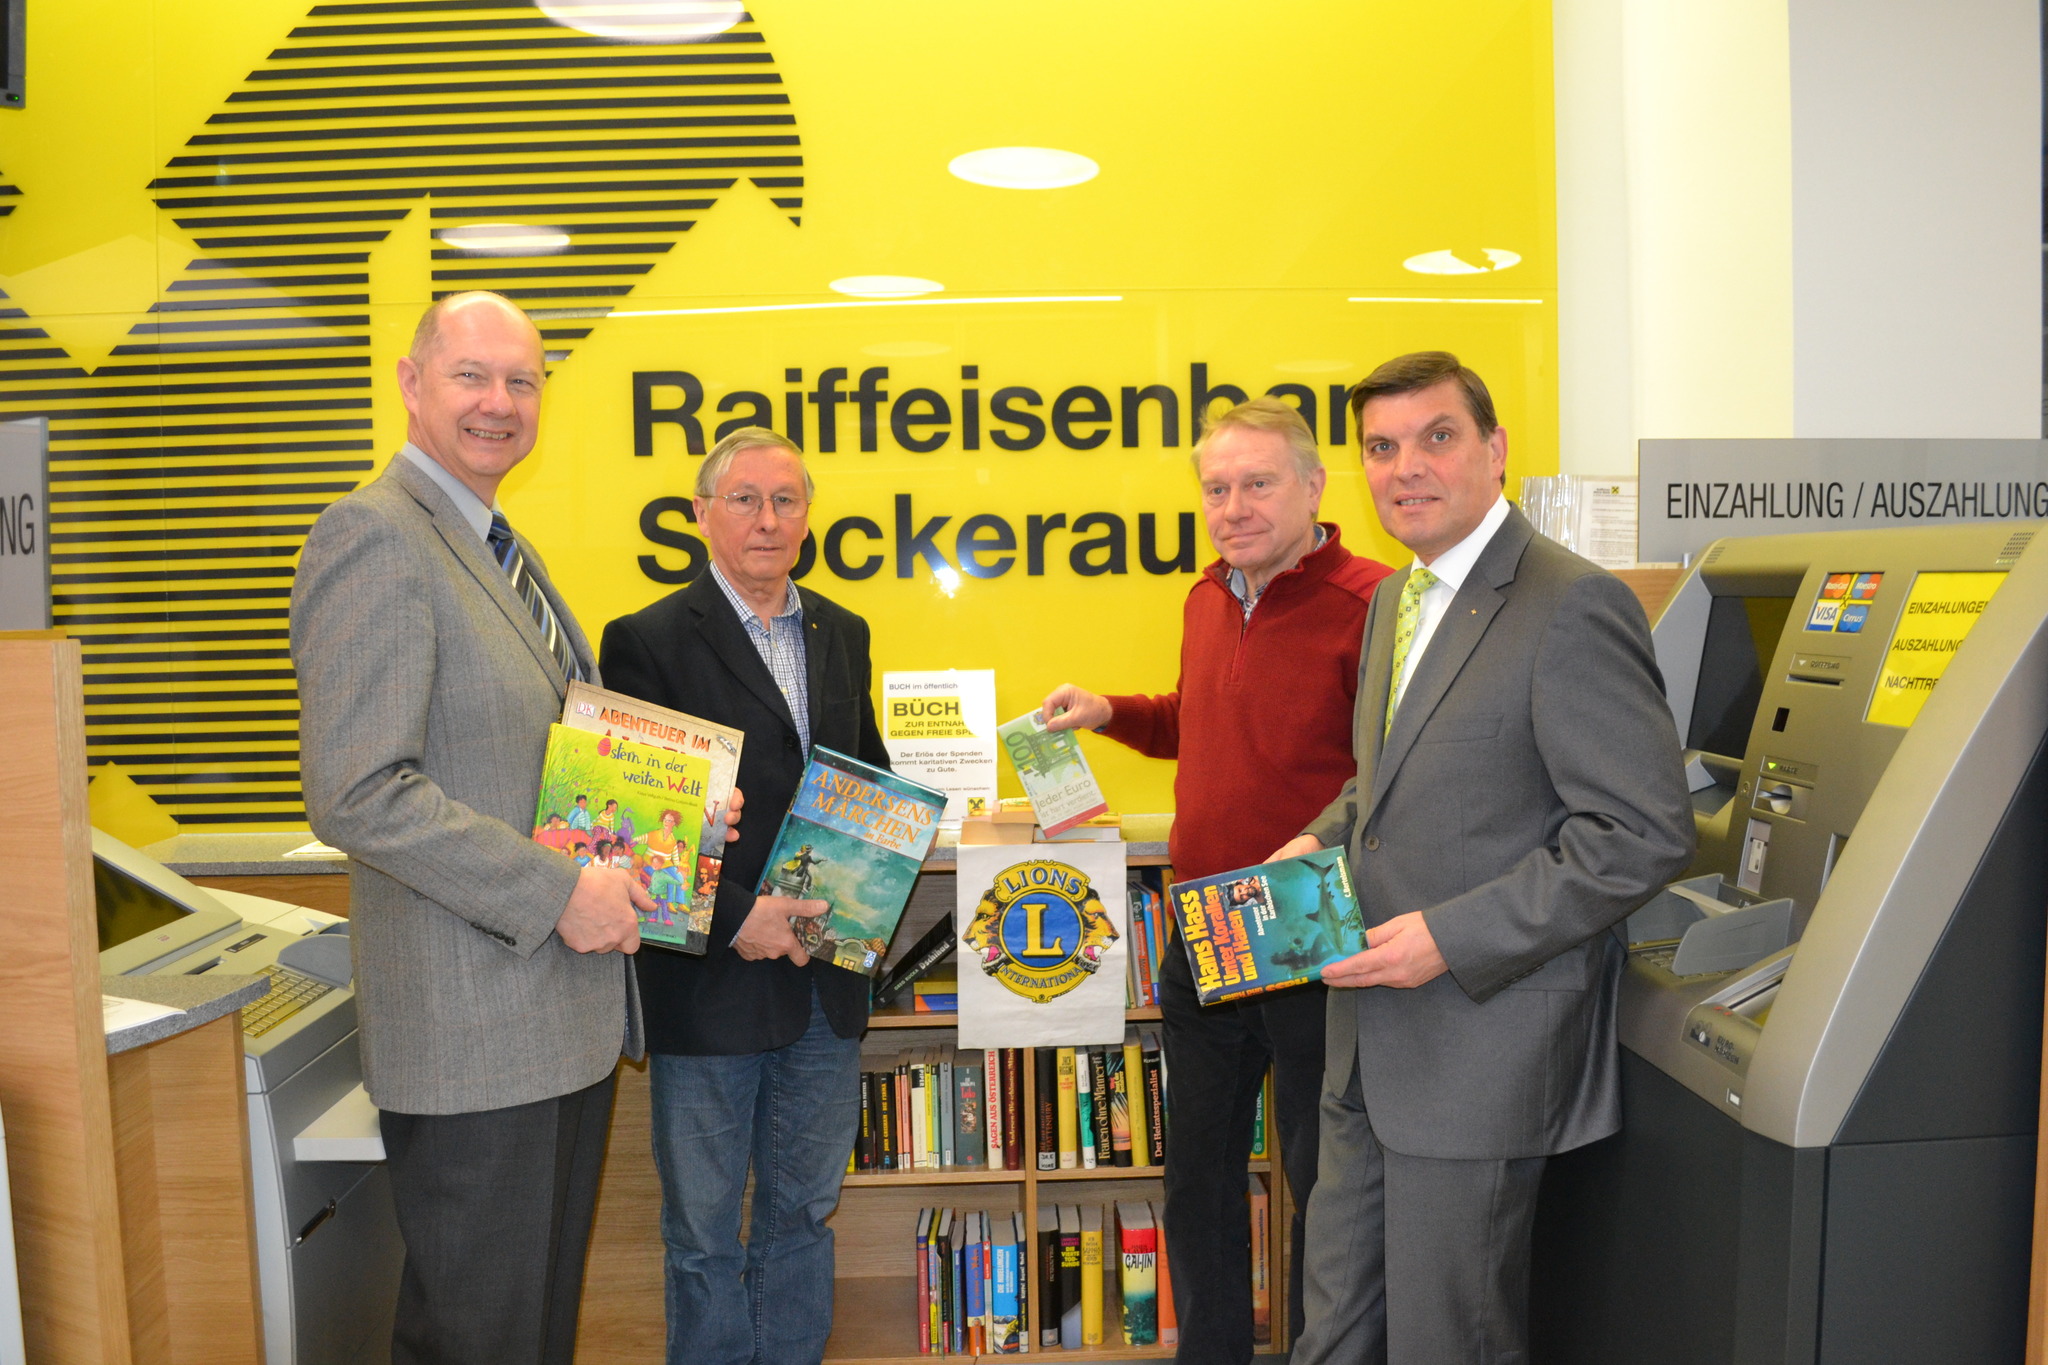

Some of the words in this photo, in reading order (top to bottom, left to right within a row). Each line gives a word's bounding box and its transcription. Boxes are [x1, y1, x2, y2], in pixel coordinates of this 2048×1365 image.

[632, 362, 1358, 457] Raiffeisenban
[1666, 482, 1844, 520] EINZAHLUNG
[1870, 481, 2048, 519] AUSZAHLUNG
[637, 493, 1196, 585] Sckerau
[1815, 606, 1838, 621] VISA
[1843, 613, 1864, 623] Cirrus
[578, 702, 595, 717] DK
[893, 698, 959, 717] BÜCH
[599, 706, 687, 746] ABENTEUER
[691, 734, 710, 753] IM
[890, 729, 924, 737] GEGEN
[646, 756, 661, 769] in
[666, 757, 687, 774] der
[891, 758, 917, 766] kommt
[919, 758, 958, 766] karitativen
[915, 750, 934, 758] Erlös
[950, 750, 983, 758] Spenden
[623, 770, 665, 789] weiten
[666, 775, 702, 798] Welt
[812, 769, 936, 826] ANDERSENS
[1035, 791, 1063, 813] Jeder
[1064, 779, 1091, 796] Euro
[811, 792, 921, 844] MÄRCHEN
[864, 831, 875, 840] in
[875, 834, 902, 850] Farbe
[1002, 866, 1083, 894] LIONS
[1260, 875, 1268, 888] See
[1179, 889, 1210, 942] Hass
[1202, 884, 1231, 946] Korallen
[1021, 903, 1066, 959] L
[1227, 909, 1251, 952] Haien
[1193, 940, 1223, 993] Hans
[1218, 943, 1242, 986] Unter
[1235, 952, 1259, 981] und
[987, 1050, 997, 1103] ÖSTERREICH
[1093, 1065, 1106, 1101] Männer
[989, 1104, 997, 1120] AUS
[1096, 1100, 1108, 1129] ohne
[1150, 1069, 1162, 1142] Heiratsspezialist
[990, 1121, 998, 1149] SAGEN
[1098, 1129, 1111, 1159] Frauen
[1154, 1142, 1163, 1157] Der
